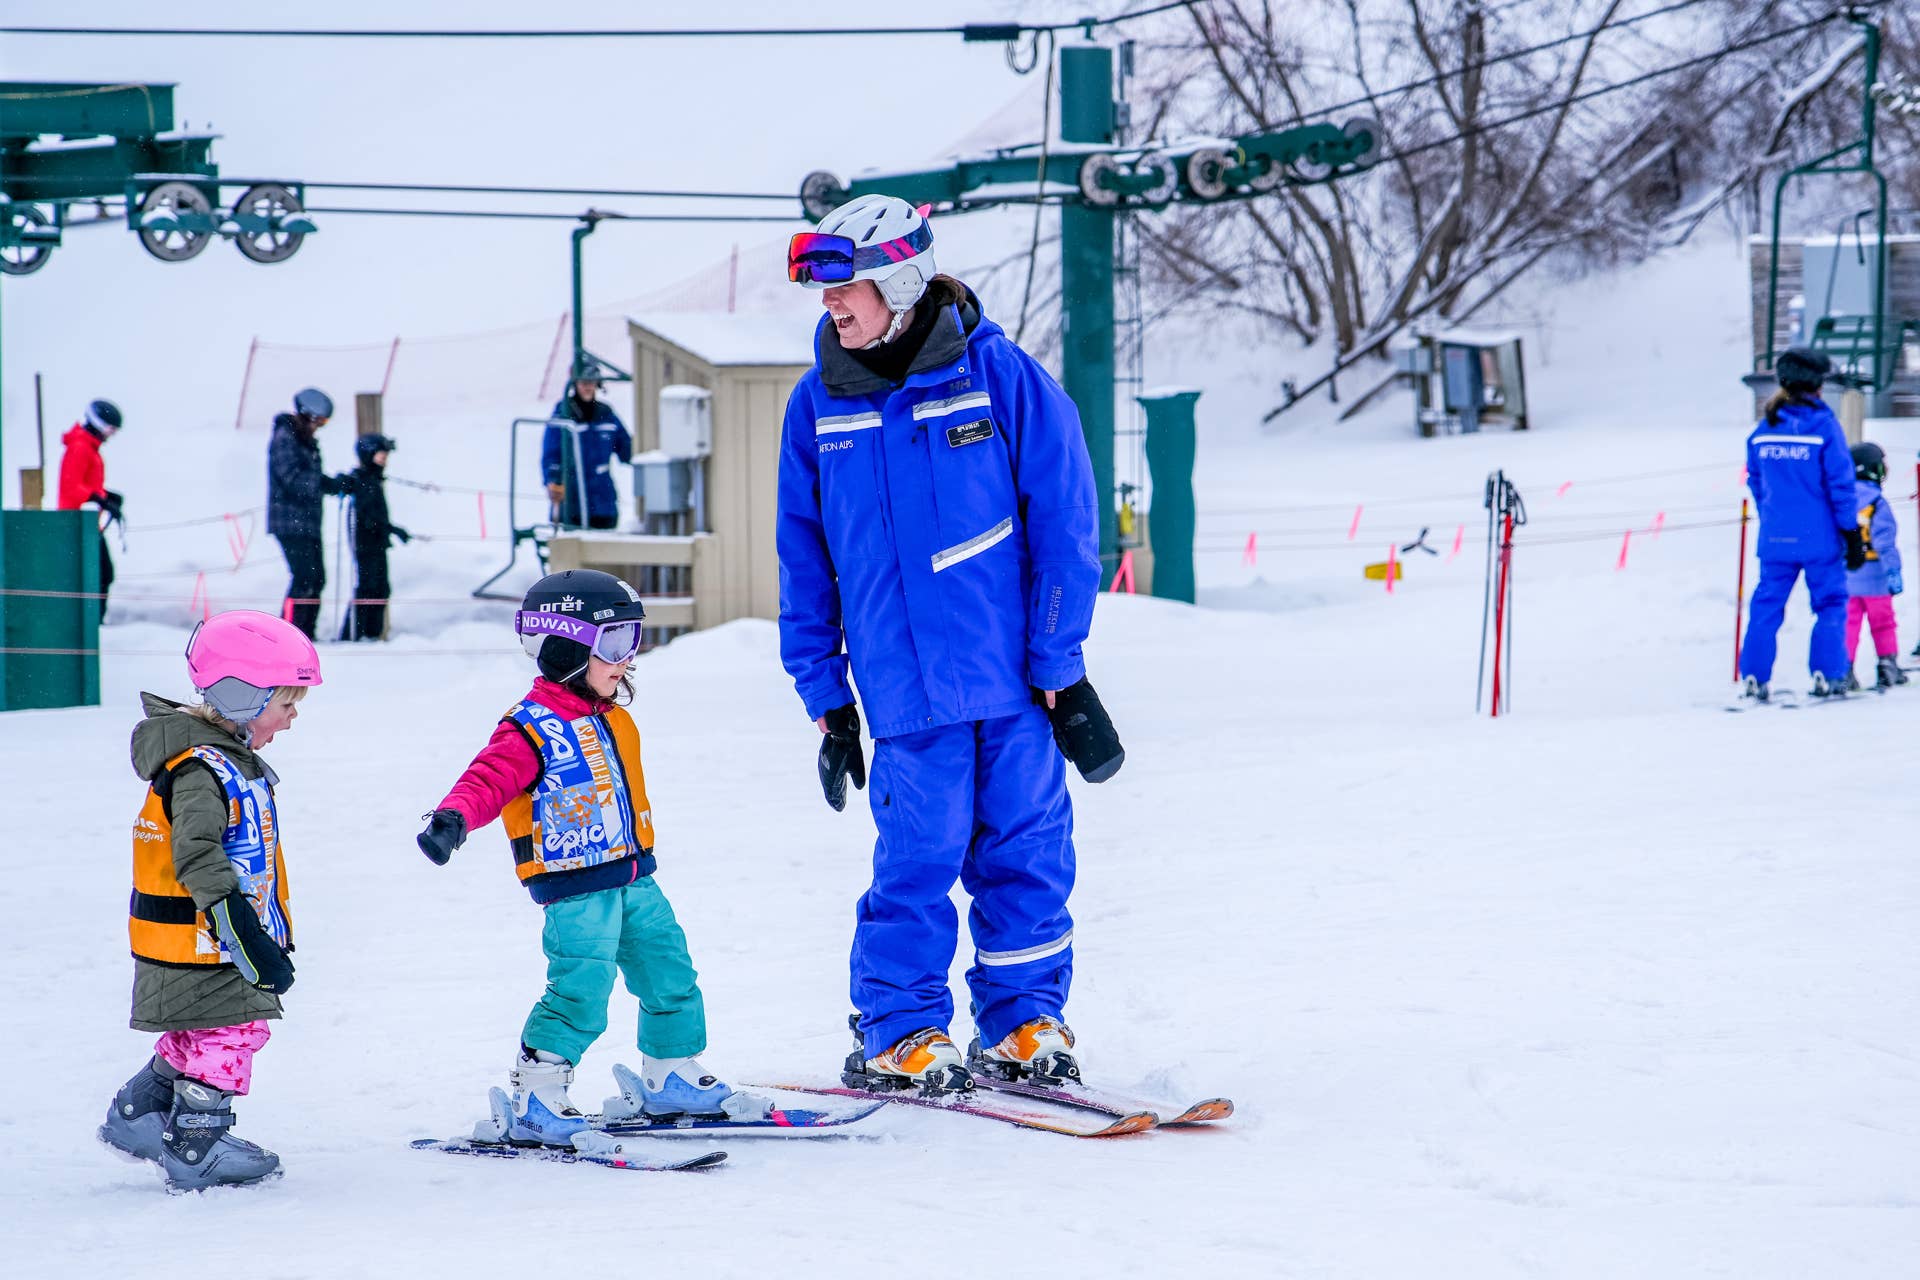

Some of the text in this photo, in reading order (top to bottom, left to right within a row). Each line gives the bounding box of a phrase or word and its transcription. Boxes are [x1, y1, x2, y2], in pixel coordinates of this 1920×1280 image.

[819, 439, 854, 453] AFTON ALPS
[1759, 445, 1810, 460] AFTON ALPS
[517, 616, 584, 636] NDWAY
[297, 667, 316, 675] SMITH
[576, 725, 611, 785] AFTON ALPS
[261, 811, 275, 875] AFTON ALPS
[545, 824, 605, 858] epic
[516, 1117, 543, 1134] DALBELLO
